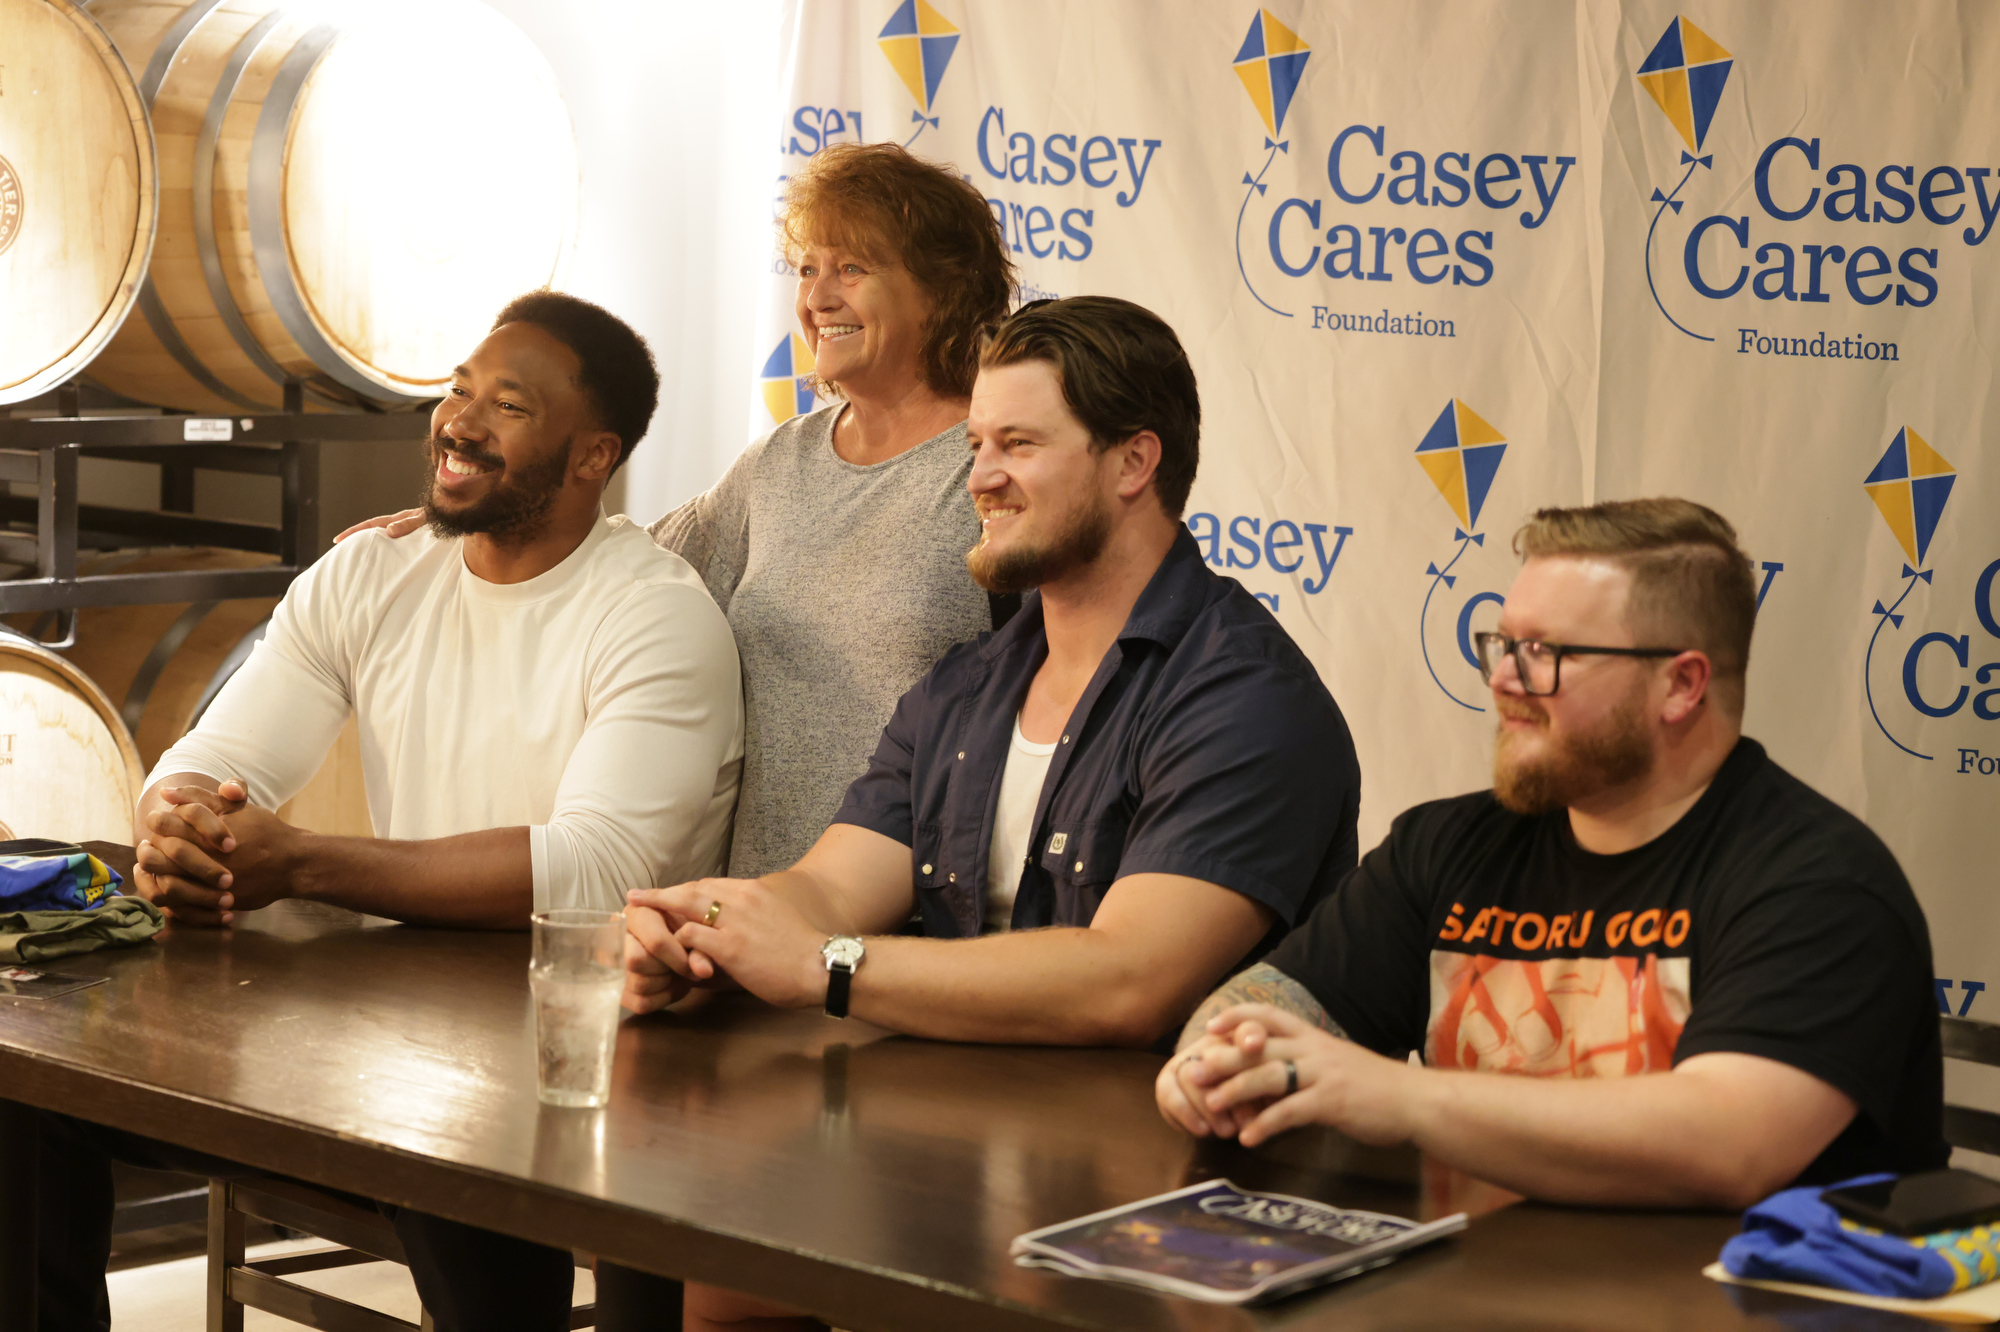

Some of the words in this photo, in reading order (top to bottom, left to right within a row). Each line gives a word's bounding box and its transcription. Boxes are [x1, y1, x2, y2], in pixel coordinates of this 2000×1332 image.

[977, 105, 1162, 208] Casey
[1327, 124, 1577, 229] Casey
[1754, 136, 2000, 246] Casey
[985, 198, 1094, 262] ares
[1268, 198, 1494, 287] Cares
[1684, 215, 1939, 308] Cares
[1311, 305, 1457, 338] Foundation
[1737, 328, 1900, 361] Foundation
[1187, 512, 1354, 595] asey
[1439, 902, 1595, 951] SATORU
